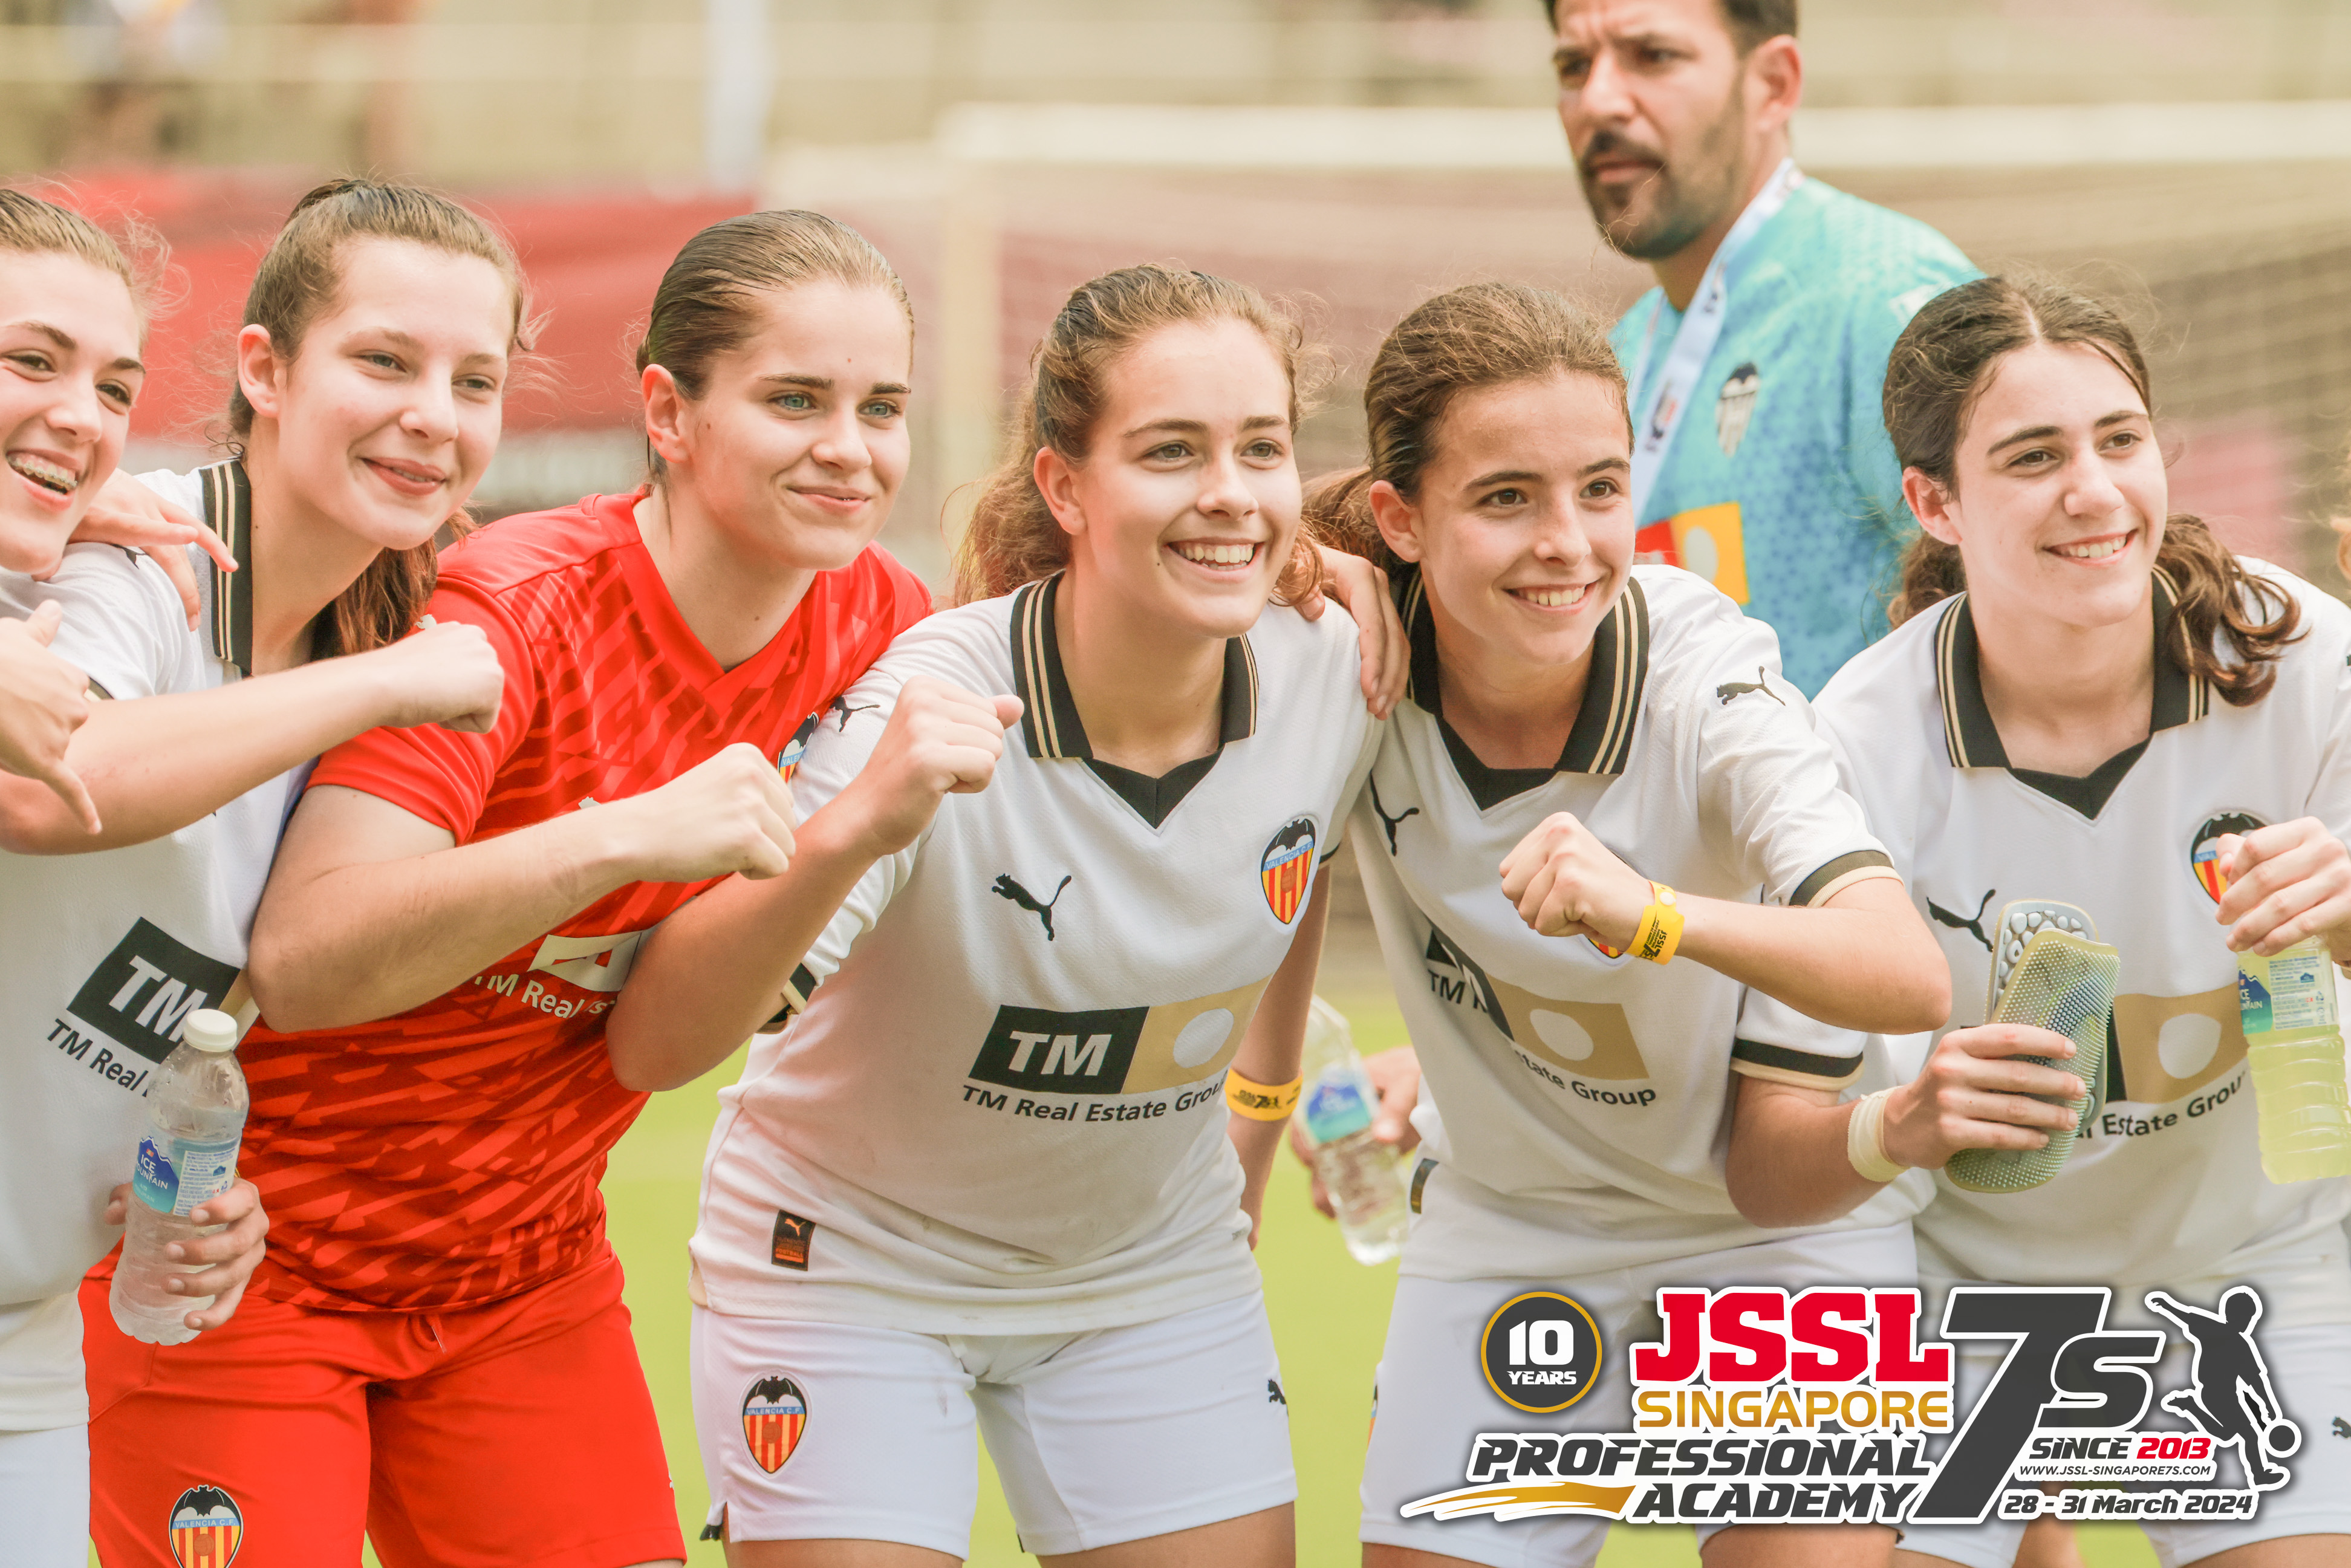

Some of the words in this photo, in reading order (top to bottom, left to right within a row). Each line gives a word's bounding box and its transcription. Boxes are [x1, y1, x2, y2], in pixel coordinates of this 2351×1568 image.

[1266, 849, 1301, 869] VALENCIA
[1654, 929, 1668, 949] JSSL
[109, 955, 208, 1043] TM
[521, 980, 585, 1018] Real
[1428, 969, 1466, 1004] TM
[47, 1018, 93, 1061] TM
[89, 1048, 149, 1091] Real
[1009, 1030, 1112, 1076] TM
[963, 1084, 1009, 1111] TM
[1014, 1098, 1079, 1122] Real
[1085, 1101, 1167, 1122] Estate
[1571, 1080, 1657, 1107] Group
[2101, 1112, 2179, 1137] Estate
[2187, 1070, 2246, 1118] Grou
[136, 1163, 169, 1190] OUNTAIN
[140, 1154, 156, 1171] ICE
[175, 1518, 217, 1529] VALENCIA
